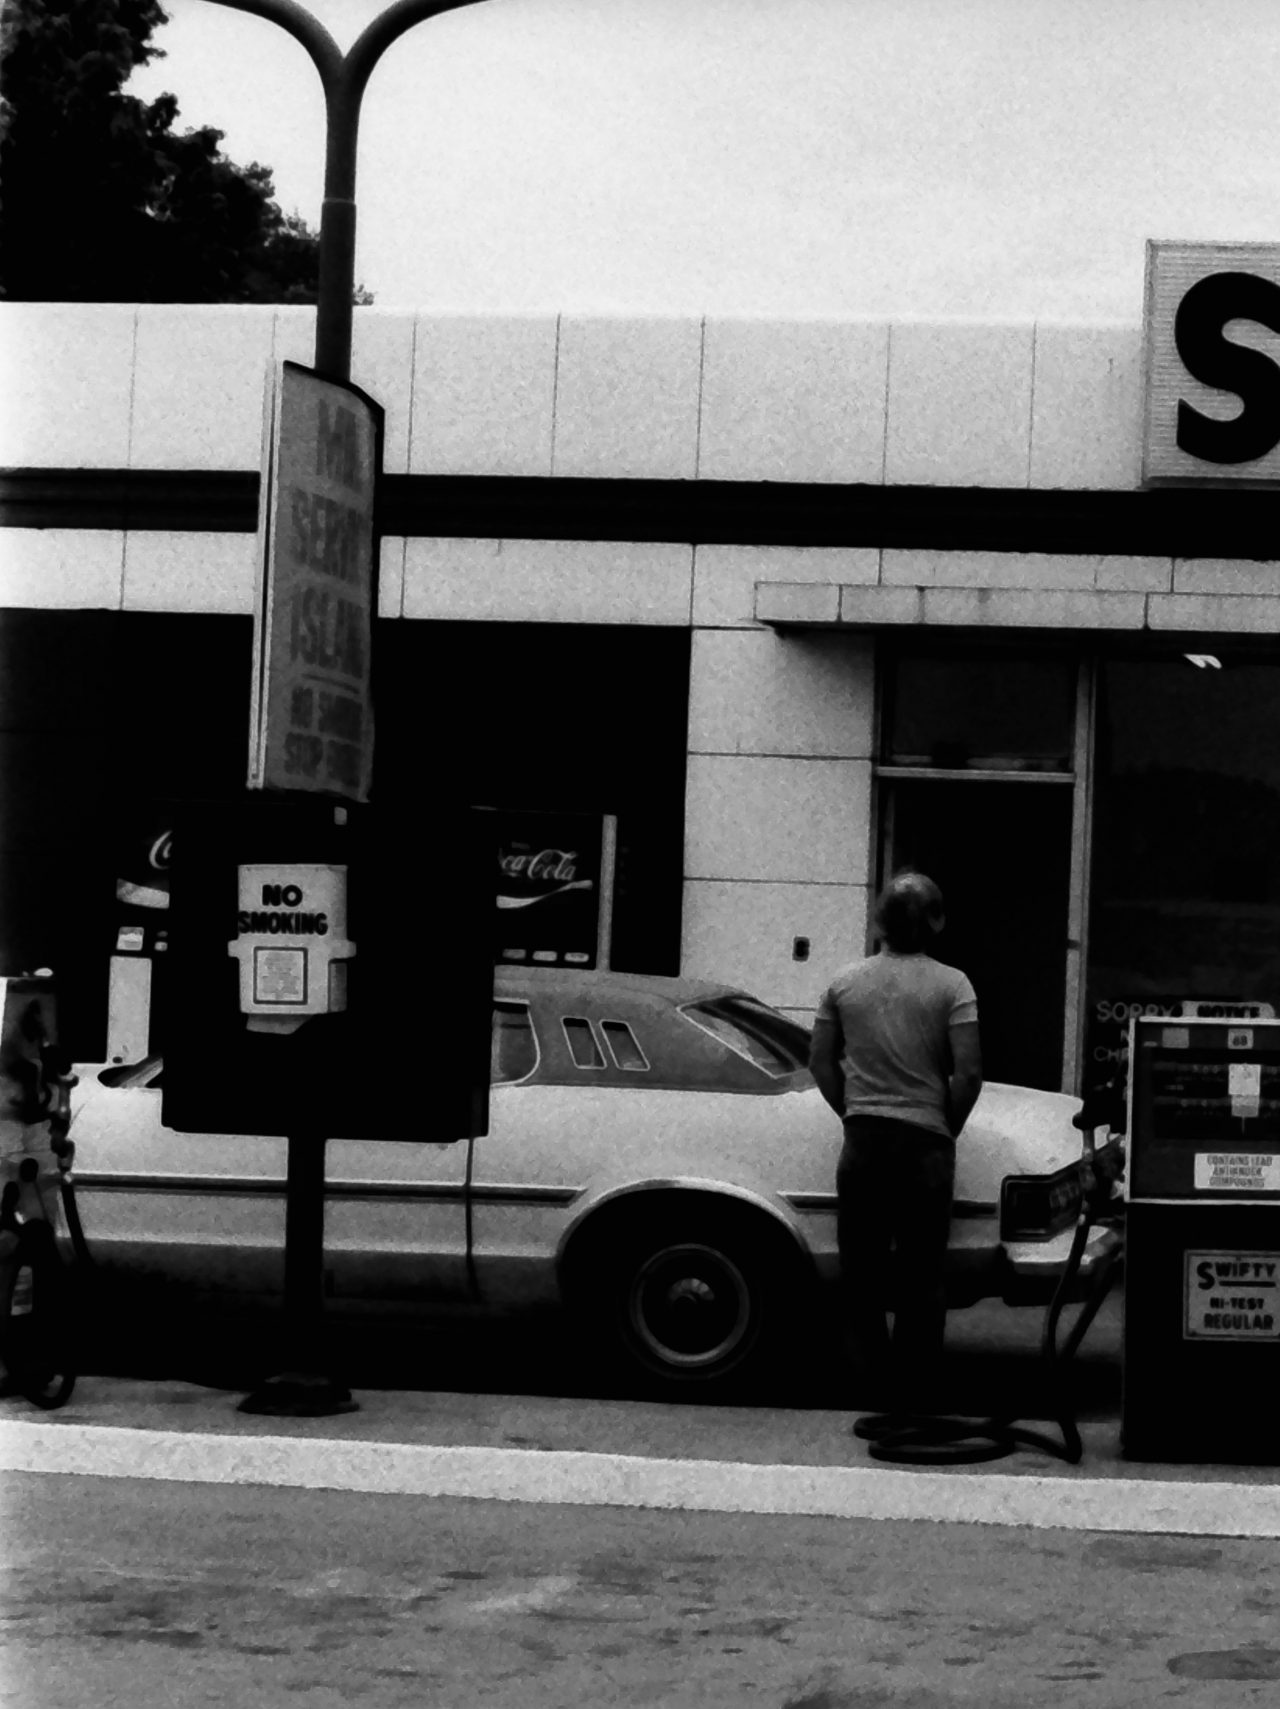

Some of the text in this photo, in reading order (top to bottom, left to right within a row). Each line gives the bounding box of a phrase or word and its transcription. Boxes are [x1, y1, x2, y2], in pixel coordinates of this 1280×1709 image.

[262, 885, 303, 907] NO
[238, 911, 329, 935] SMOKING
[1197, 1262, 1276, 1290] SWIFTY
[1210, 1297, 1265, 1310] HI-TEST
[1204, 1313, 1274, 1331] REGULAR
